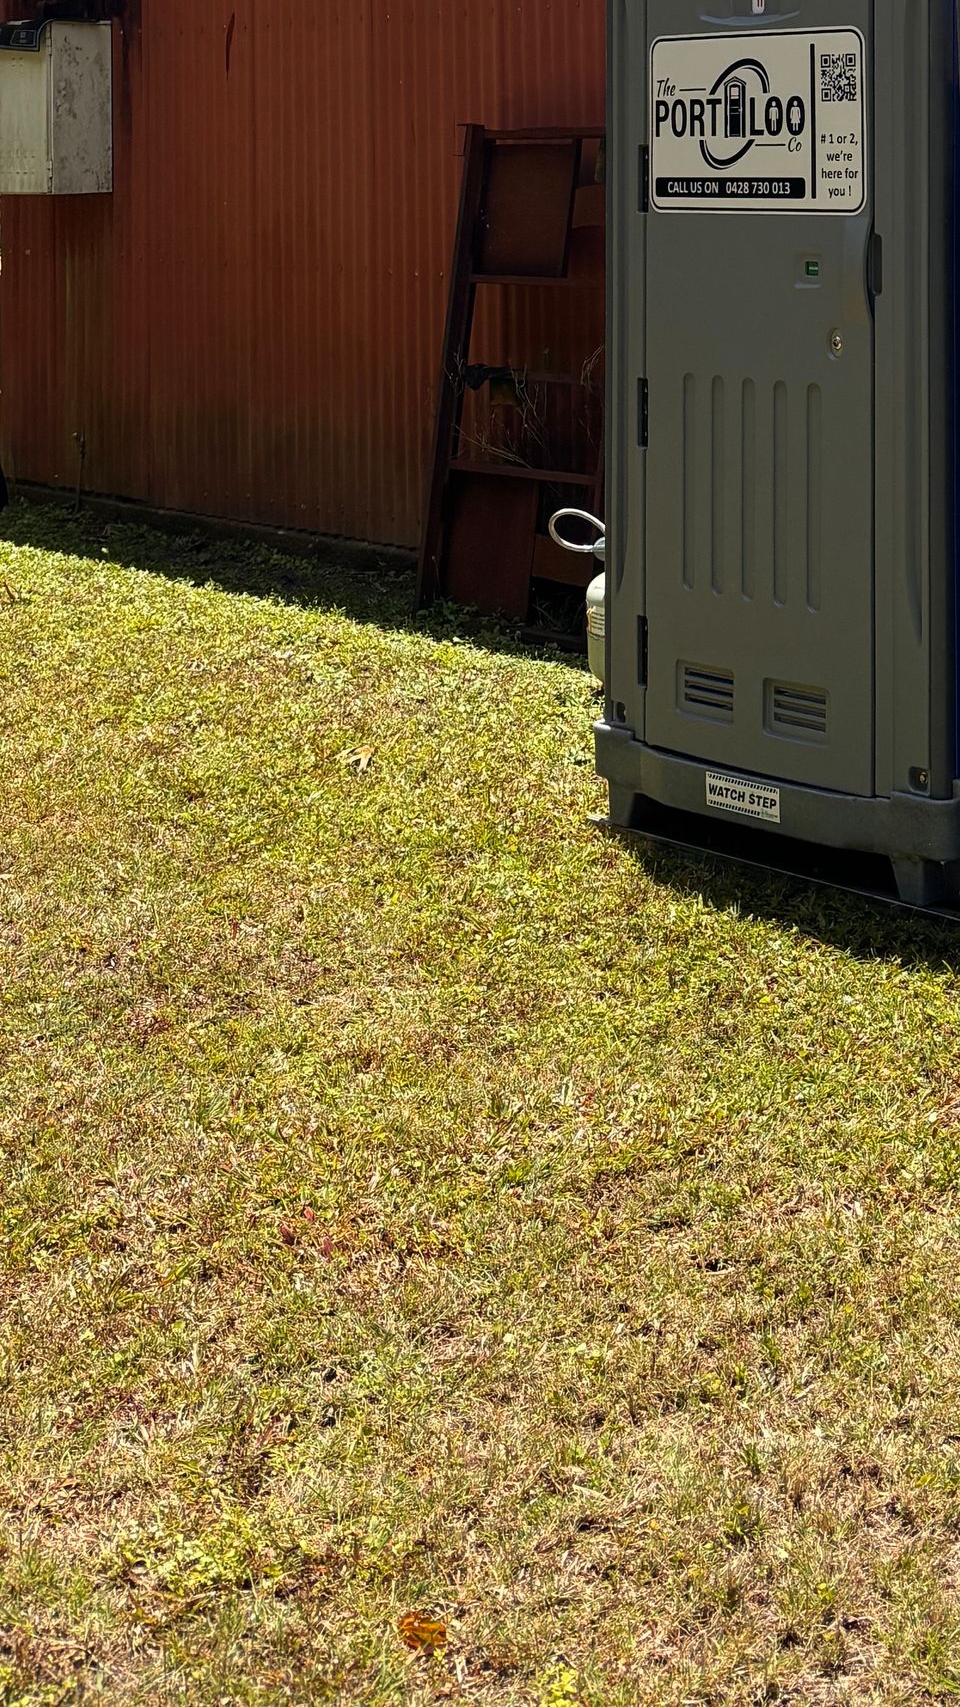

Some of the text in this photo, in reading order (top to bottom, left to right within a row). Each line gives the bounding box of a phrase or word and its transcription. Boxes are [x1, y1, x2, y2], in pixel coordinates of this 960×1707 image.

[656, 77, 676, 98] The
[787, 137, 803, 153] Co
[820, 133, 859, 146] # 1 or 2,
[821, 167, 859, 179] here for
[667, 181, 791, 195] CALL US ON 0428 730 013
[828, 187, 846, 199] you
[708, 783, 777, 810] WATCH STEP
